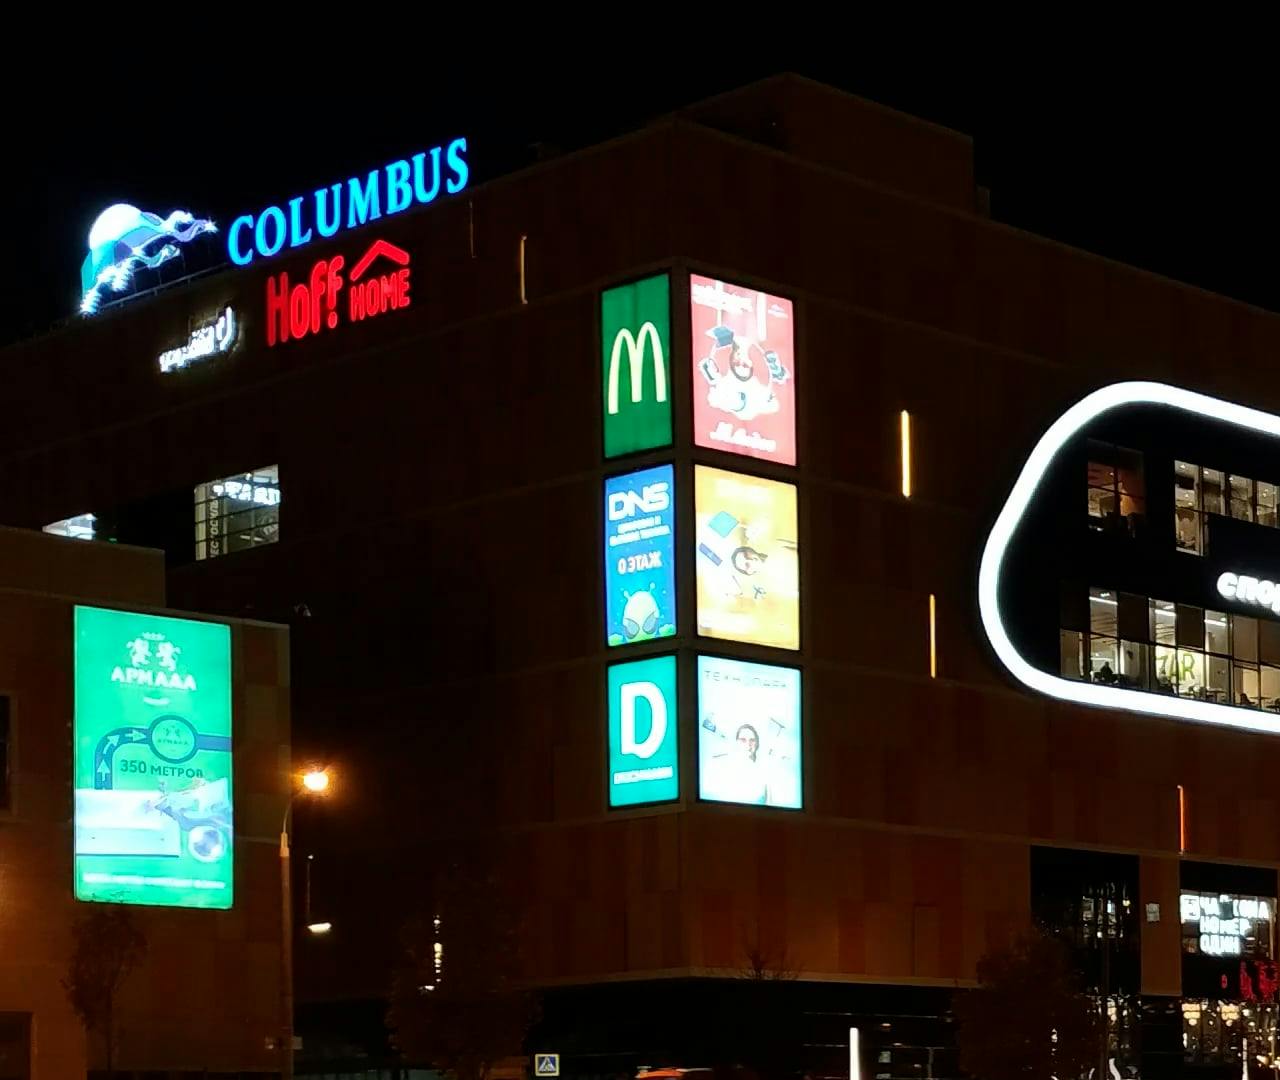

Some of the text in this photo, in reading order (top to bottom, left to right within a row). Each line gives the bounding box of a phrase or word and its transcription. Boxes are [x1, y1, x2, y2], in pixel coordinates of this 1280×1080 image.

[228, 137, 469, 266] COLUMBUS
[350, 268, 411, 322] HOME
[608, 482, 670, 521] DNS
[111, 666, 196, 691] АРМАДА
[621, 681, 668, 759] D
[120, 759, 147, 774] 350
